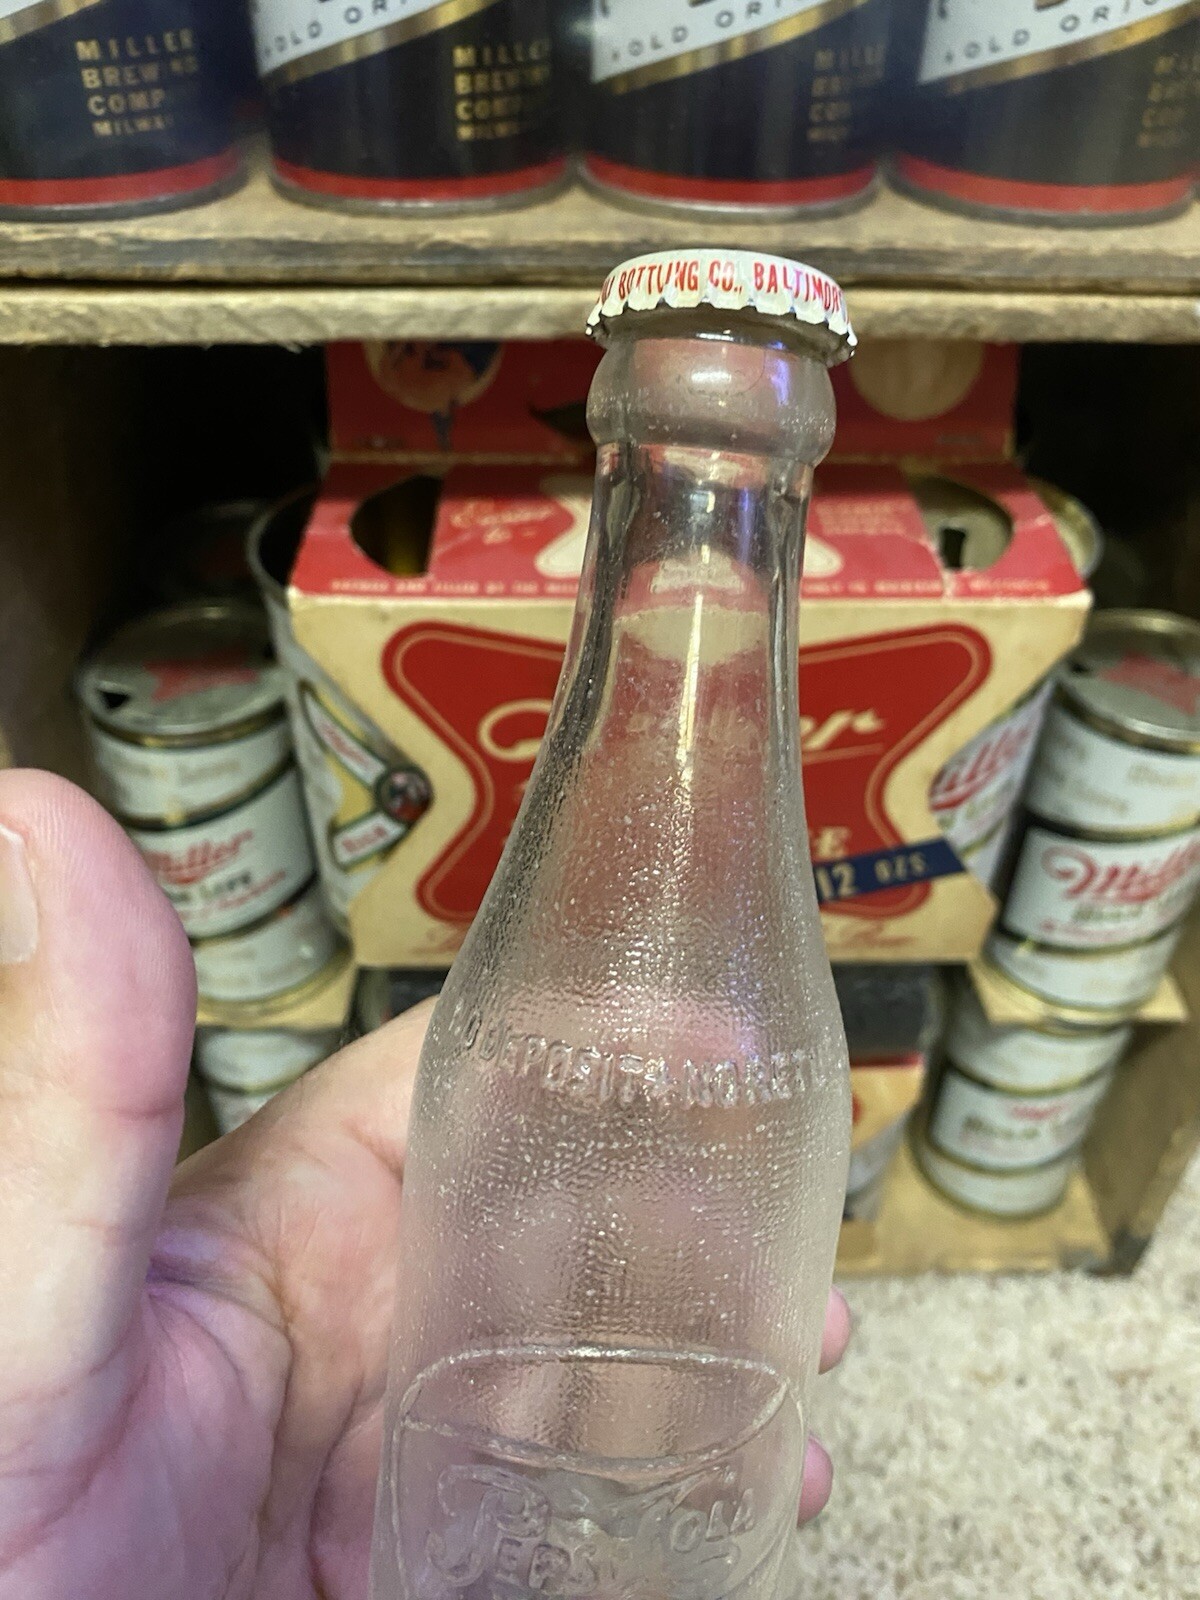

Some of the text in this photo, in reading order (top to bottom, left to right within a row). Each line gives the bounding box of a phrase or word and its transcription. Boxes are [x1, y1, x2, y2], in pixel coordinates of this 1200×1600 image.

[87, 88, 166, 116] COMP
[618, 261, 699, 300] BOTTLING
[816, 863, 855, 901] 12
